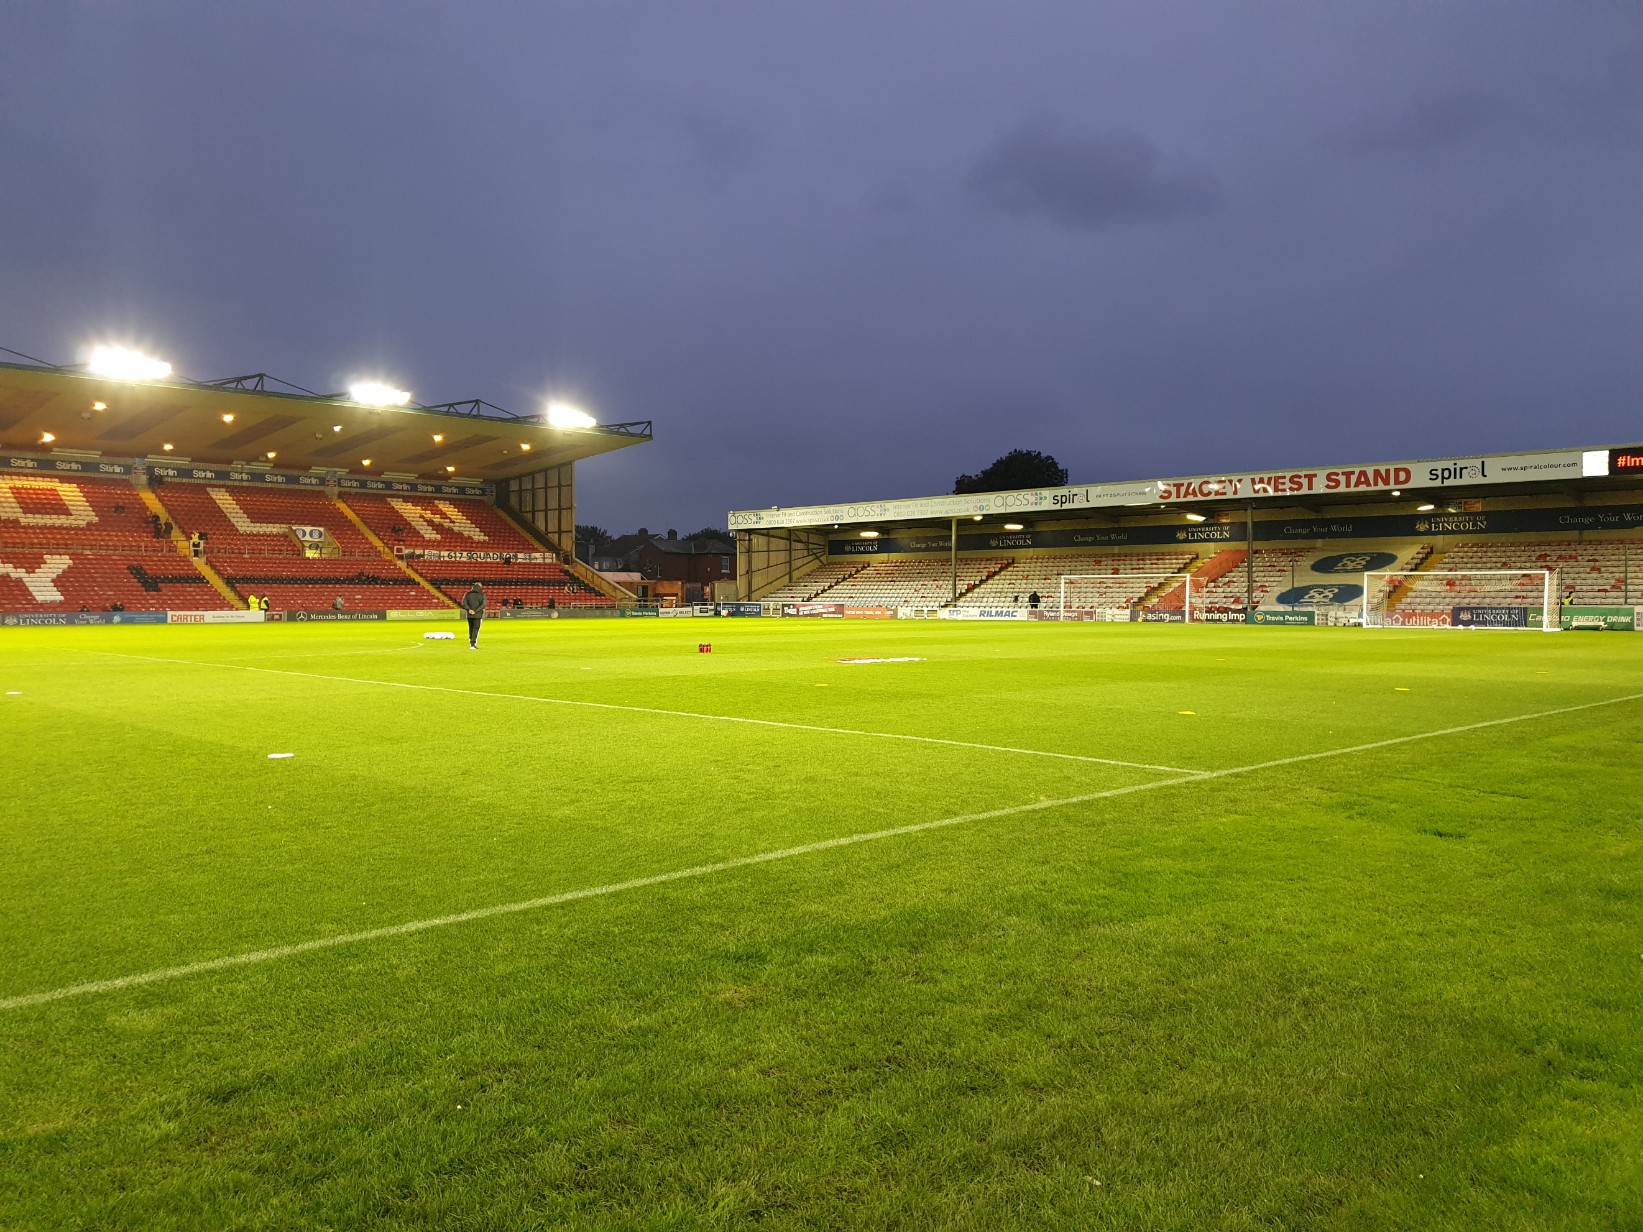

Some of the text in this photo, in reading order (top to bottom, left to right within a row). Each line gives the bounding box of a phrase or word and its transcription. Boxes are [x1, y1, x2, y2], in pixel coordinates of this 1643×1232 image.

[10, 458, 37, 468] Stirlin
[56, 461, 82, 470] Stirlin
[1501, 461, 1578, 472] www.spiralcolour.com
[100, 464, 124, 473] Stirlin
[154, 468, 178, 477] Stirlin
[1428, 460, 1488, 485] spiral
[192, 470, 214, 479] Stirlin
[230, 472, 250, 481] Stirlin
[265, 474, 286, 483] Stirlin
[299, 476, 319, 485] Stirlin
[1159, 467, 1412, 500] STACEY WEST STAND
[994, 494, 1030, 512] apss
[1052, 489, 1090, 508] spiral
[848, 506, 876, 519] apss
[728, 513, 752, 528] apss
[1559, 515, 1594, 524] Change
[1598, 513, 1620, 522] Your
[1284, 524, 1352, 534] Change Your World
[1431, 521, 1486, 532] LINCOLN
[1188, 531, 1230, 540] LINCOLN
[852, 544, 878, 552] LINCOLN
[448, 552, 463, 560] 617
[170, 614, 205, 622] CARTER
[1194, 611, 1245, 622] Running Imp
[1405, 616, 1438, 626] utilita
